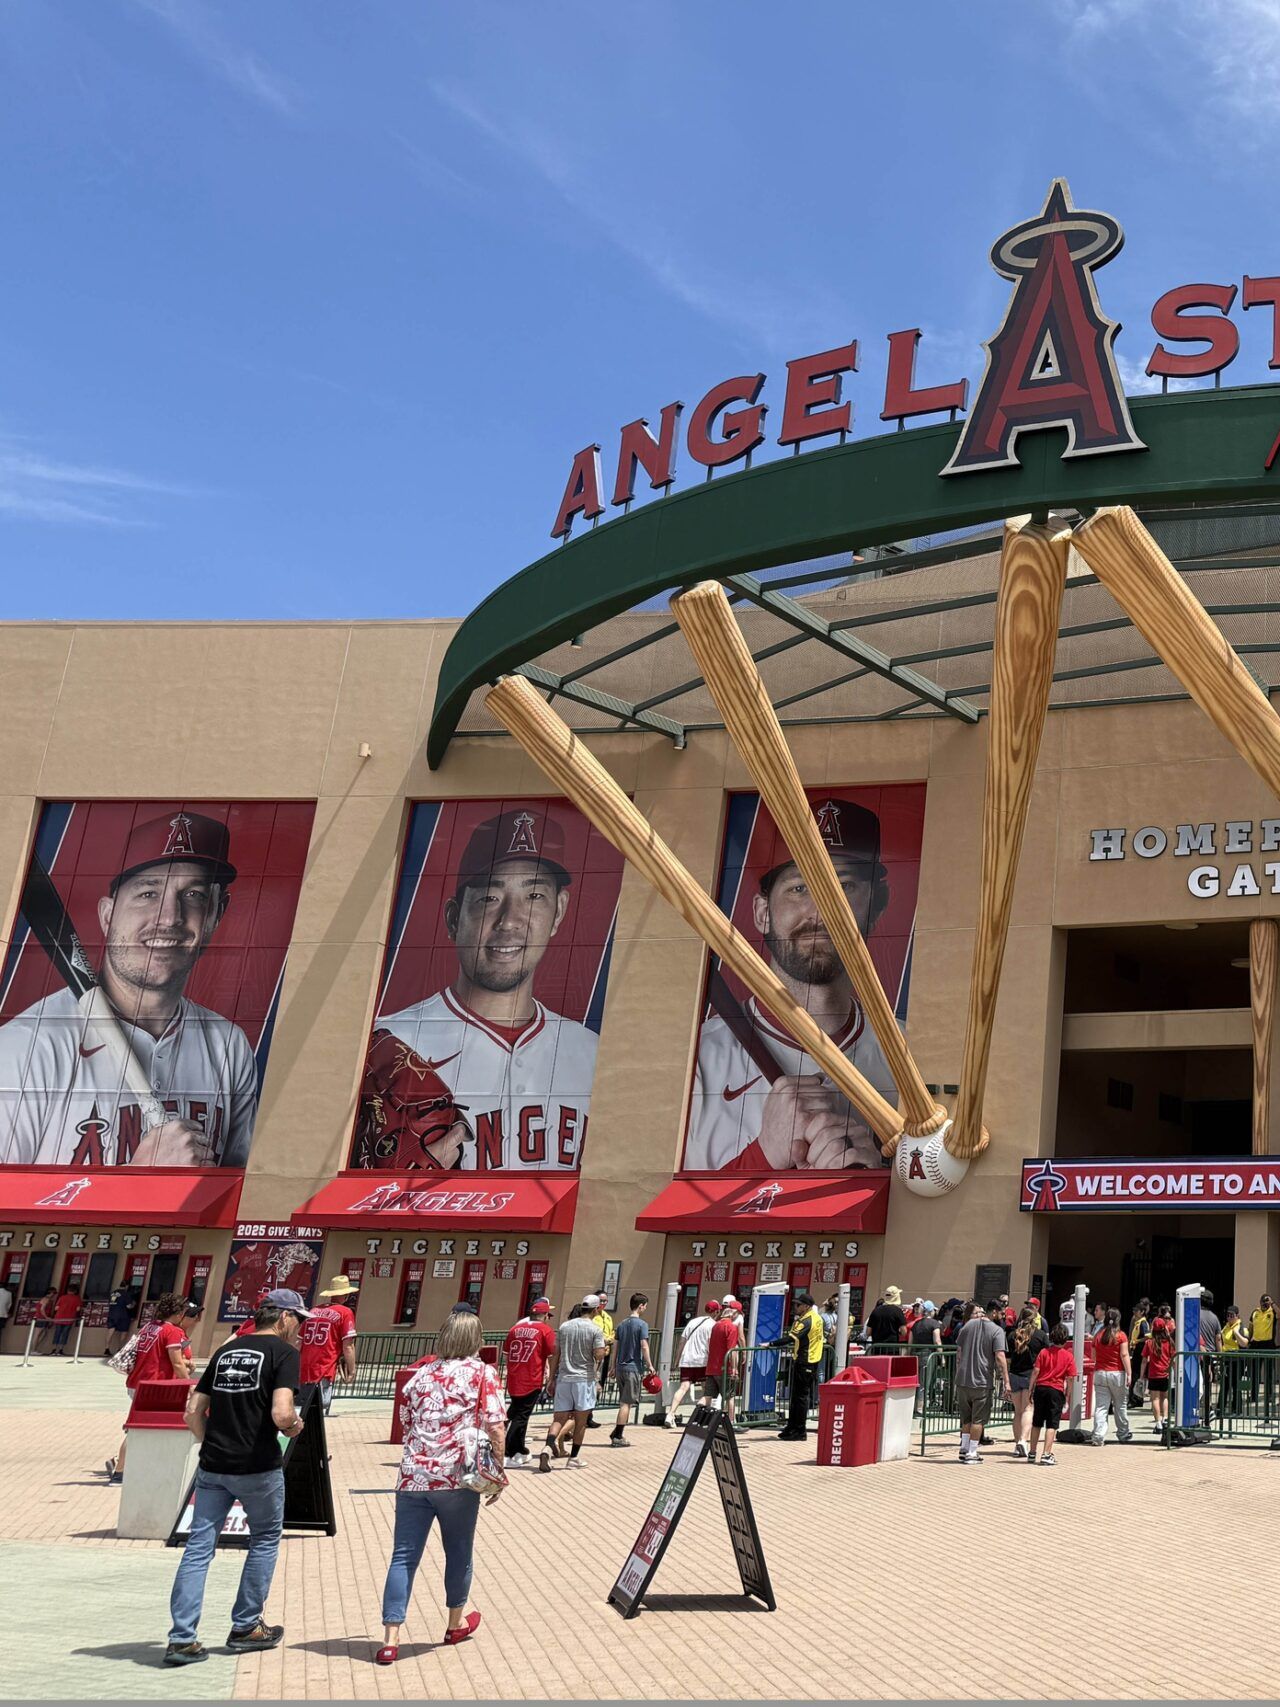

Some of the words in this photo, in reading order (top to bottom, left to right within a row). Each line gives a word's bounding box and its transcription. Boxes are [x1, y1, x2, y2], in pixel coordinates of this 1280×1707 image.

[551, 328, 969, 538] ANGEL
[938, 176, 1148, 478] A
[161, 811, 195, 856] A
[507, 812, 538, 853] A
[908, 1146, 926, 1180] A
[34, 1178, 92, 1206] A
[347, 1182, 515, 1212] ANGELS
[734, 1182, 783, 1213] A
[1076, 1174, 1204, 1196] WELCOME
[1209, 1174, 1243, 1195] TO
[0, 1232, 162, 1250] TICKETS
[236, 1224, 267, 1236] 2025
[367, 1239, 530, 1256] TICKETS
[691, 1242, 859, 1258] TICKETS
[304, 1322, 330, 1345] 55
[219, 1357, 240, 1365] SALTY
[509, 1340, 538, 1363] 27
[830, 1404, 845, 1465] RECYCLE
